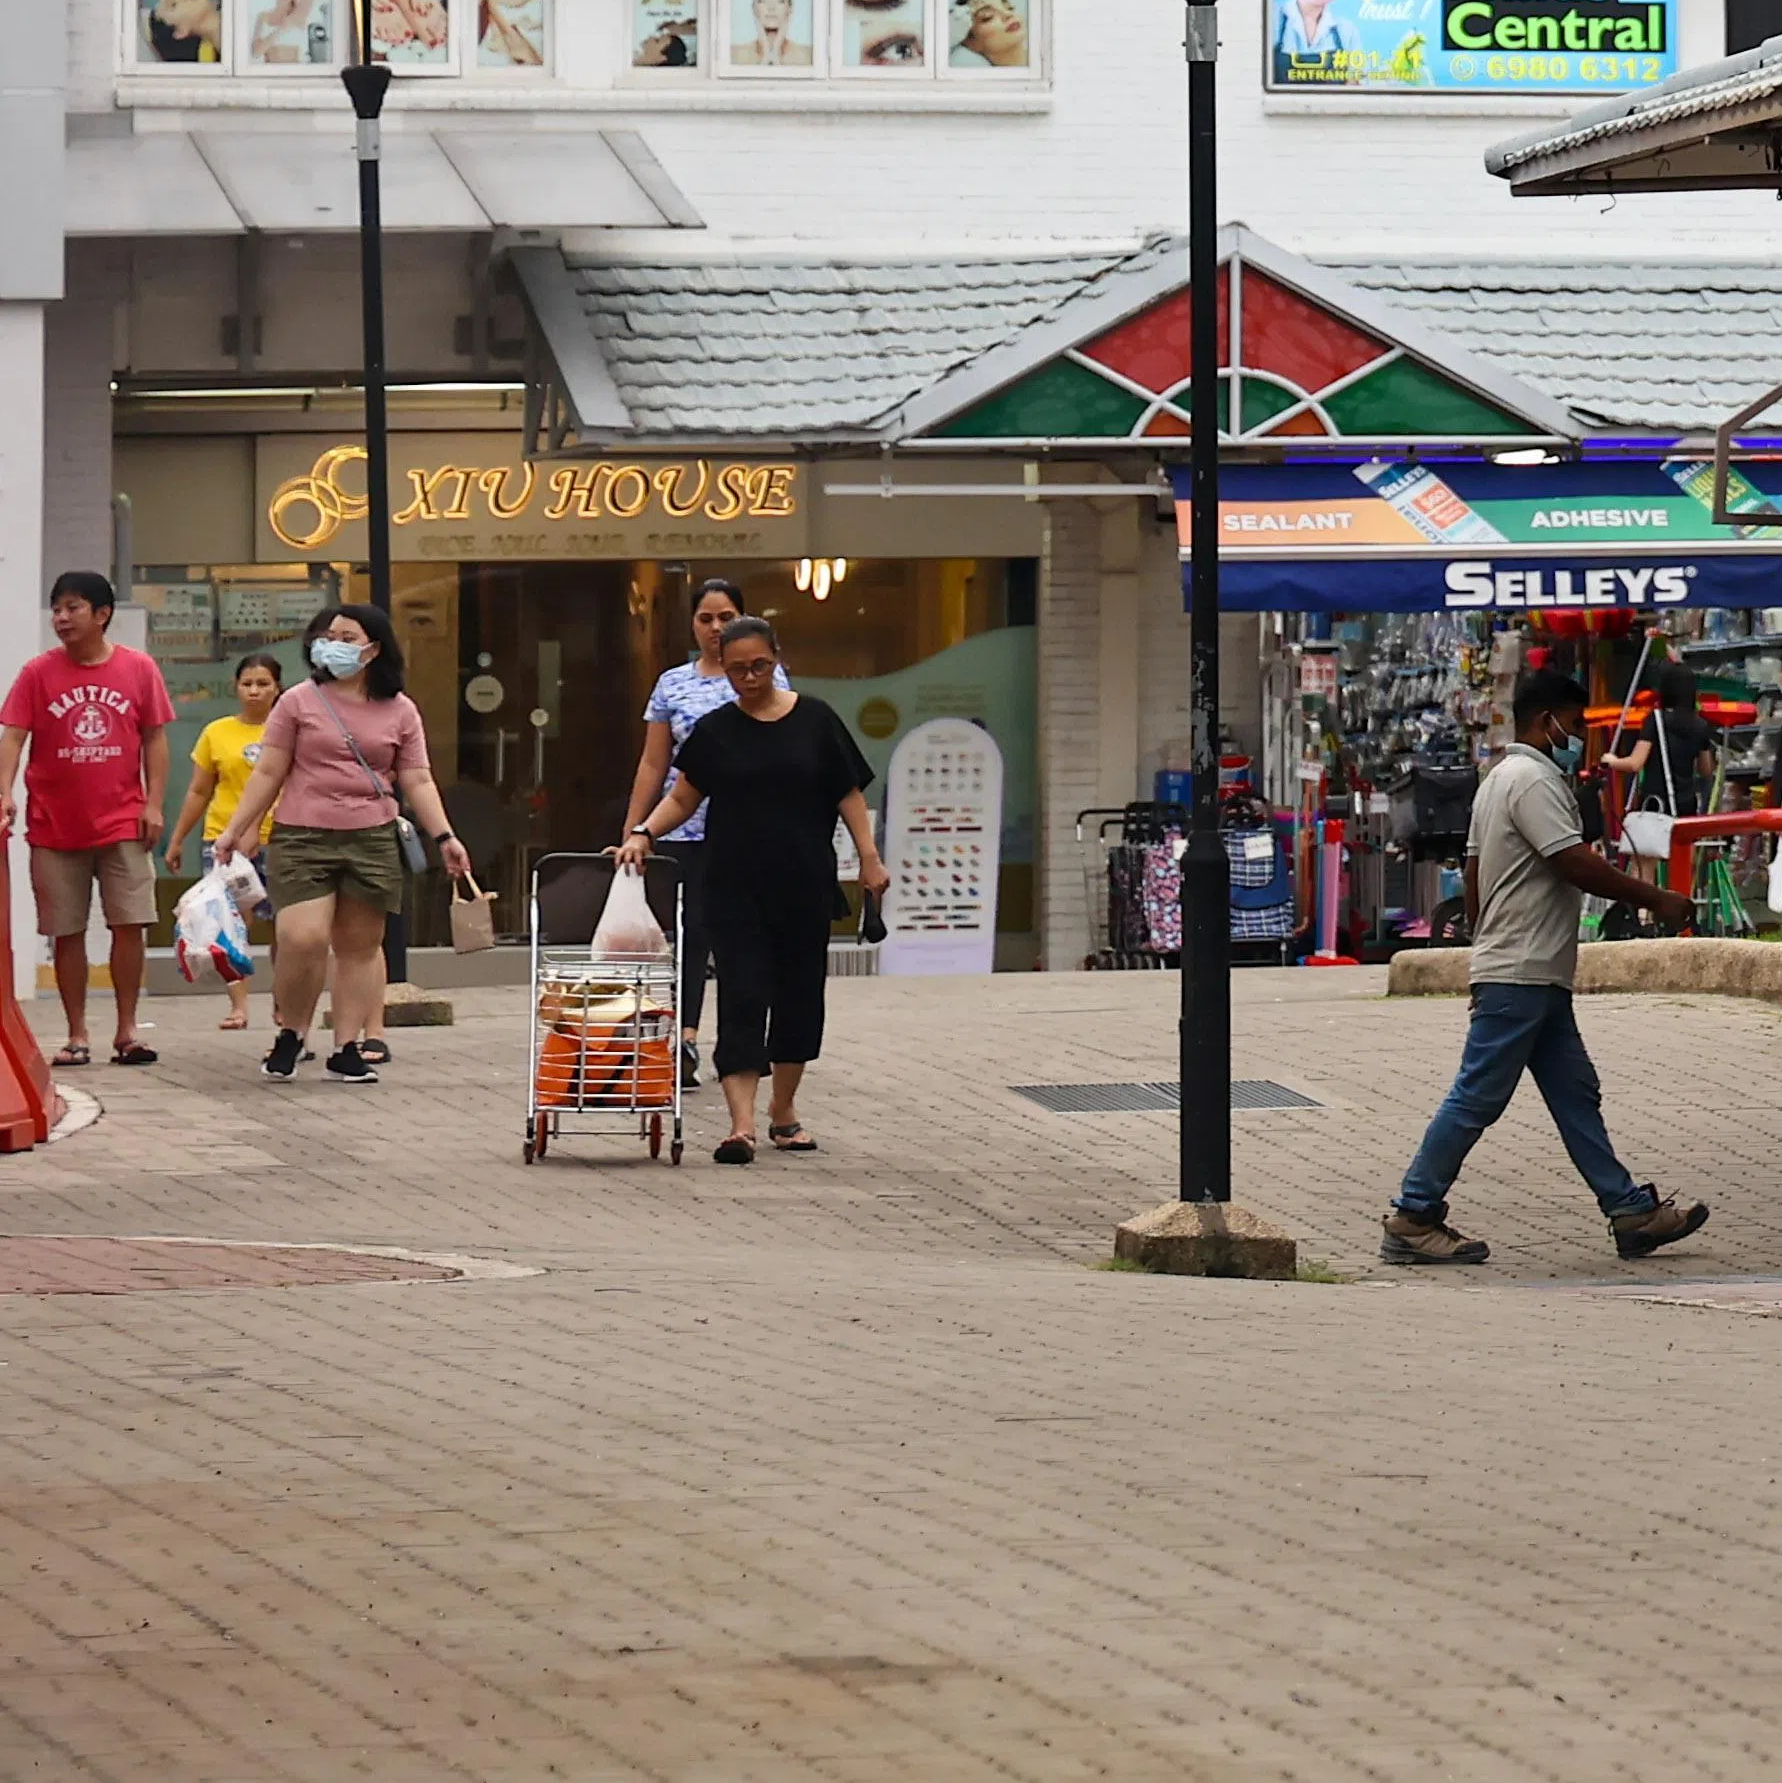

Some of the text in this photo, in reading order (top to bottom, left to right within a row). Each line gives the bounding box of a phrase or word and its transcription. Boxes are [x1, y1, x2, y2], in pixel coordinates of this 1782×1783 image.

[1447, 2, 1663, 51] Central
[1487, 56, 1661, 82] 6980 6312
[392, 460, 796, 524] XIU HOUSE
[1224, 512, 1352, 531] SEALANT
[1532, 508, 1668, 528] ADHESIVE
[1444, 561, 1688, 607] SELLEYS
[48, 685, 130, 719] NAUTICA
